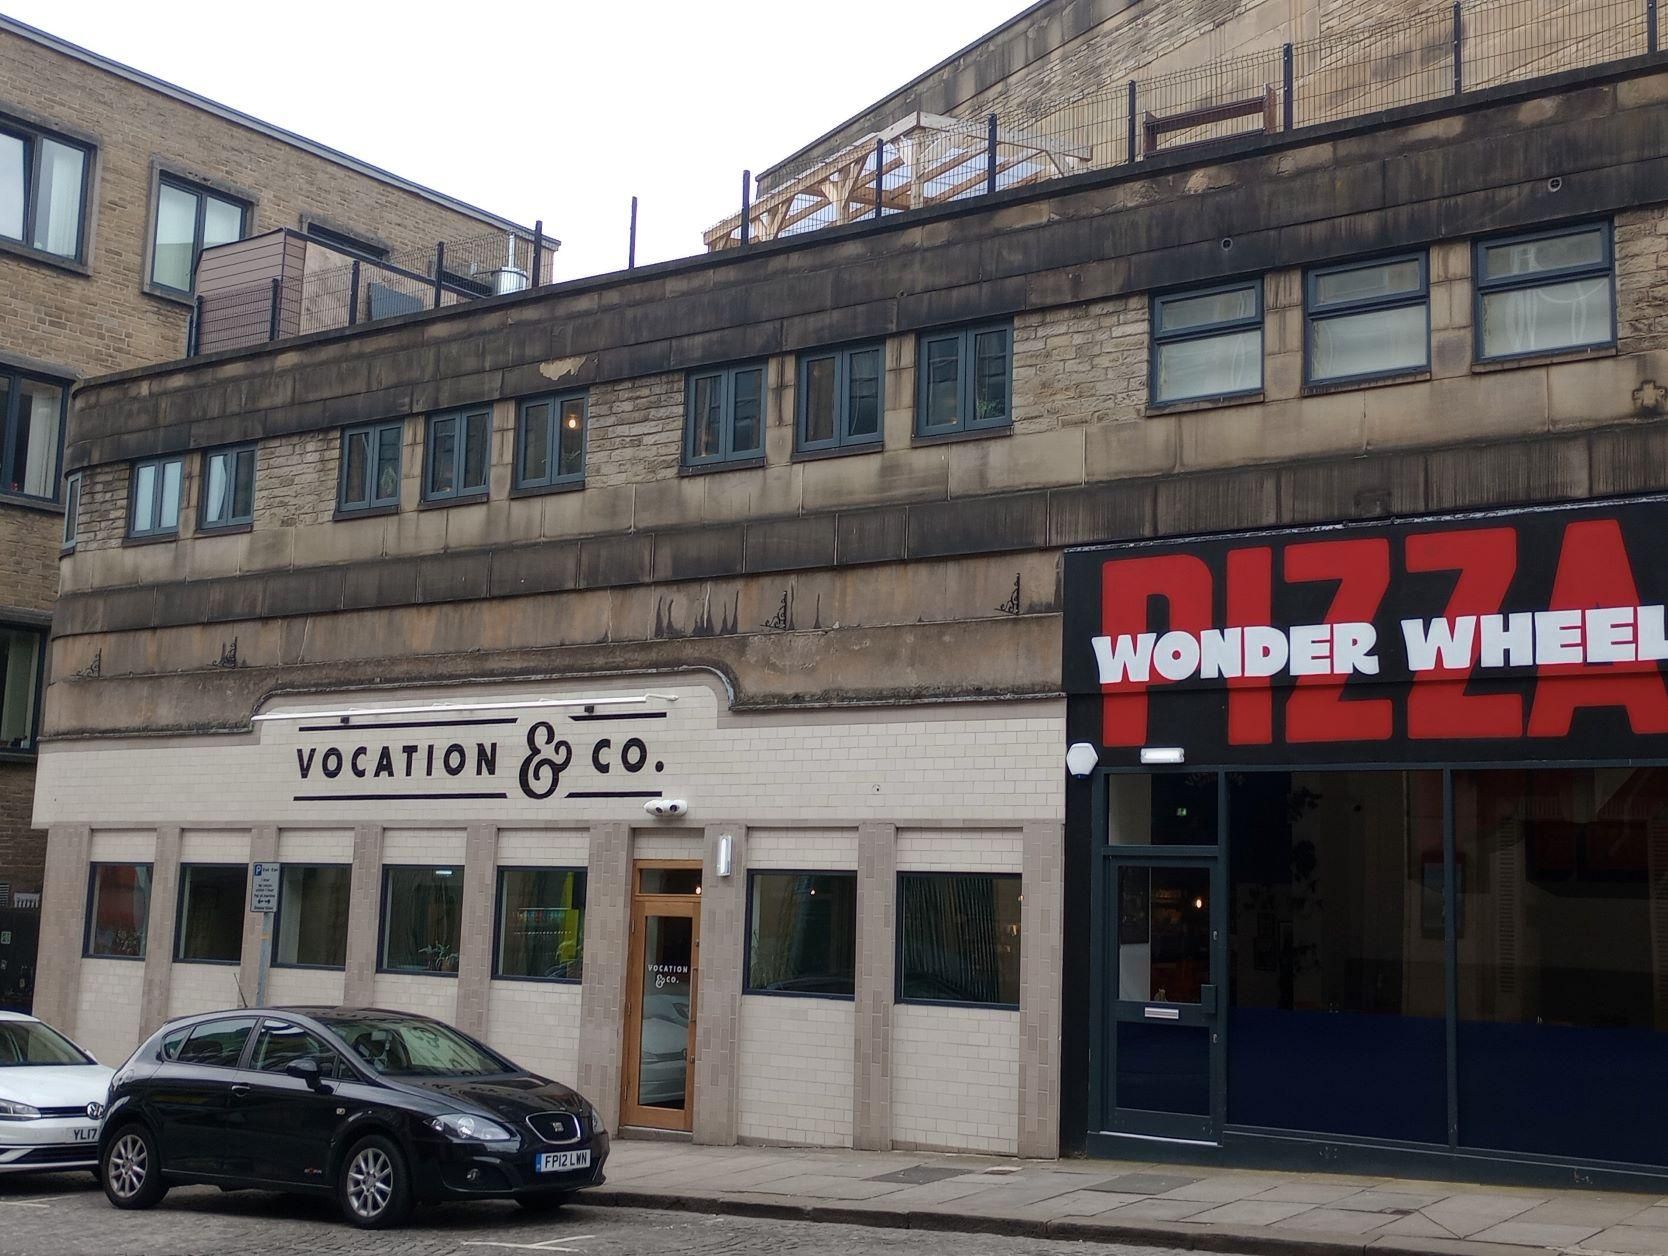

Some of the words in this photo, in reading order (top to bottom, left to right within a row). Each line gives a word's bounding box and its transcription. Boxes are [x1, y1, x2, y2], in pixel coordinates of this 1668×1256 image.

[1091, 621, 1380, 684] WONDER
[1401, 605, 1668, 671] WHEEL
[1102, 519, 1668, 747] PIZZA
[296, 742, 498, 779] VOCATION
[518, 721, 573, 800] &
[591, 737, 665, 774] CO.
[647, 964, 688, 973] VOCATION
[73, 1128, 98, 1141] YL17
[545, 1153, 568, 1169] FP12
[569, 1151, 587, 1166] LWN
